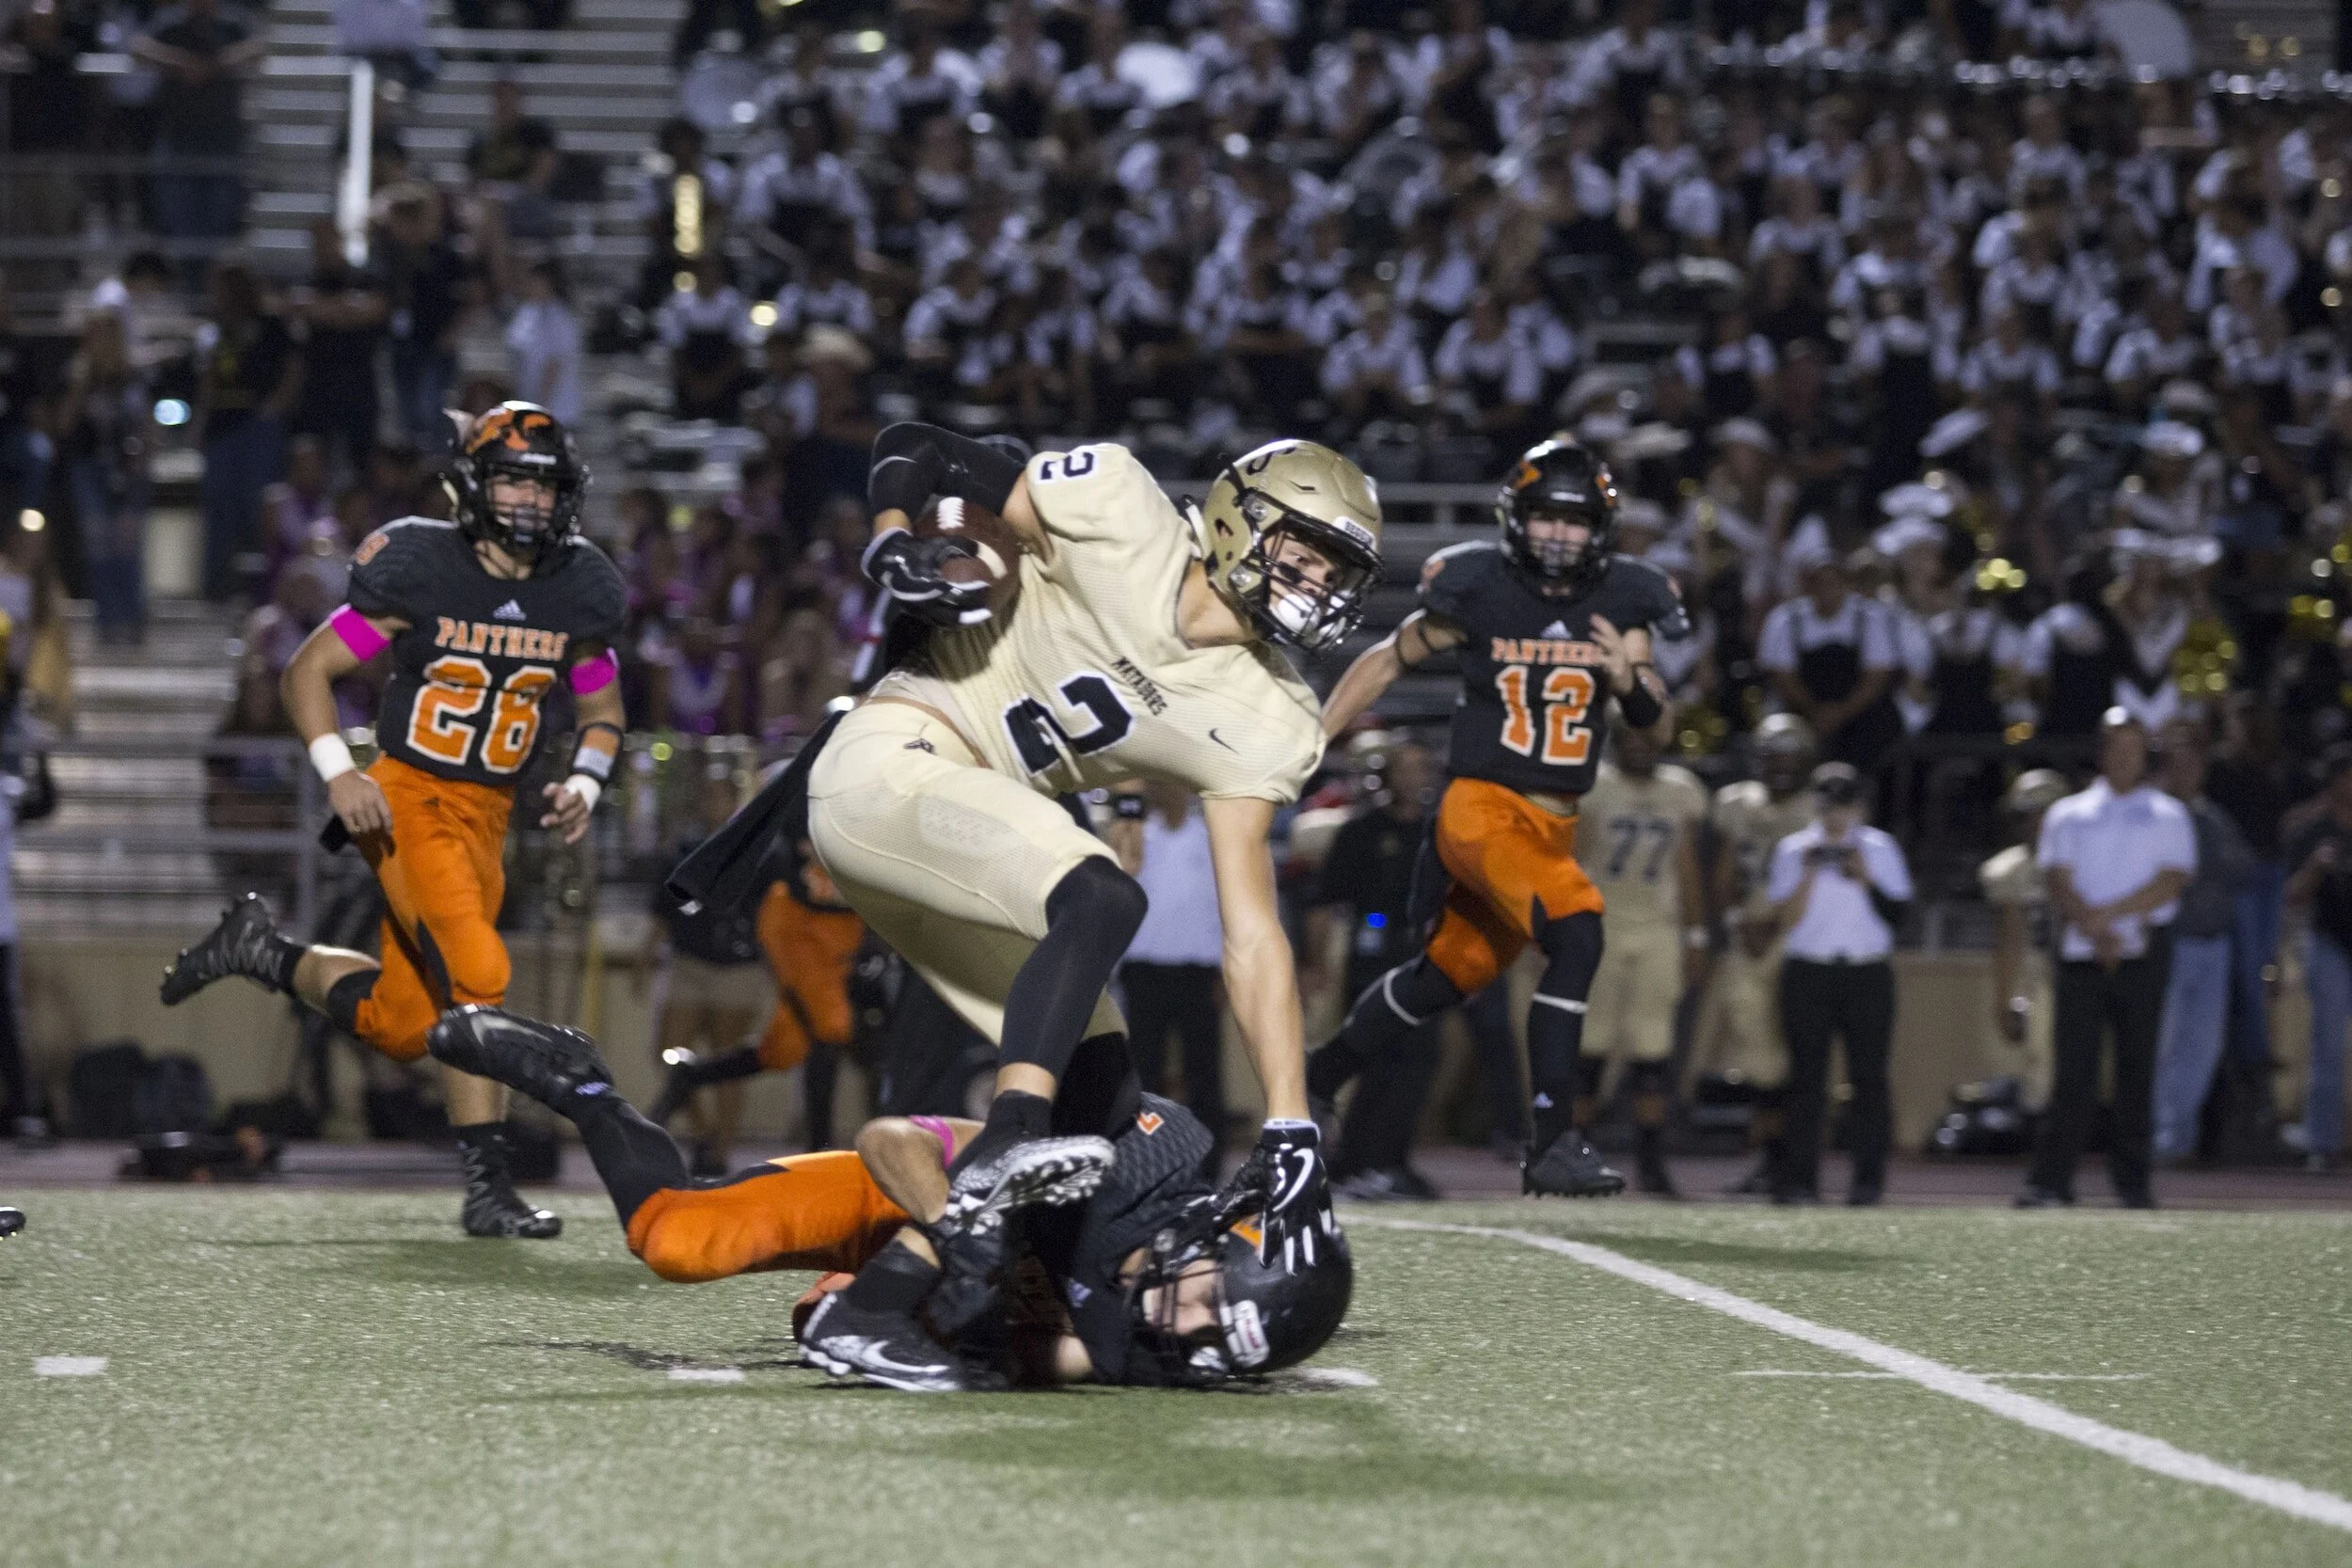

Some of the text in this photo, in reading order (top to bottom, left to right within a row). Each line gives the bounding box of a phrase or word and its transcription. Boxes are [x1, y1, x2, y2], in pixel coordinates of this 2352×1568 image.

[434, 616, 570, 662] PANTHERS
[1491, 638, 1601, 667] PANTHER
[406, 656, 557, 773] 28
[1005, 673, 1132, 774] 2
[1496, 665, 1596, 765] 12
[1608, 818, 1675, 881] 77
